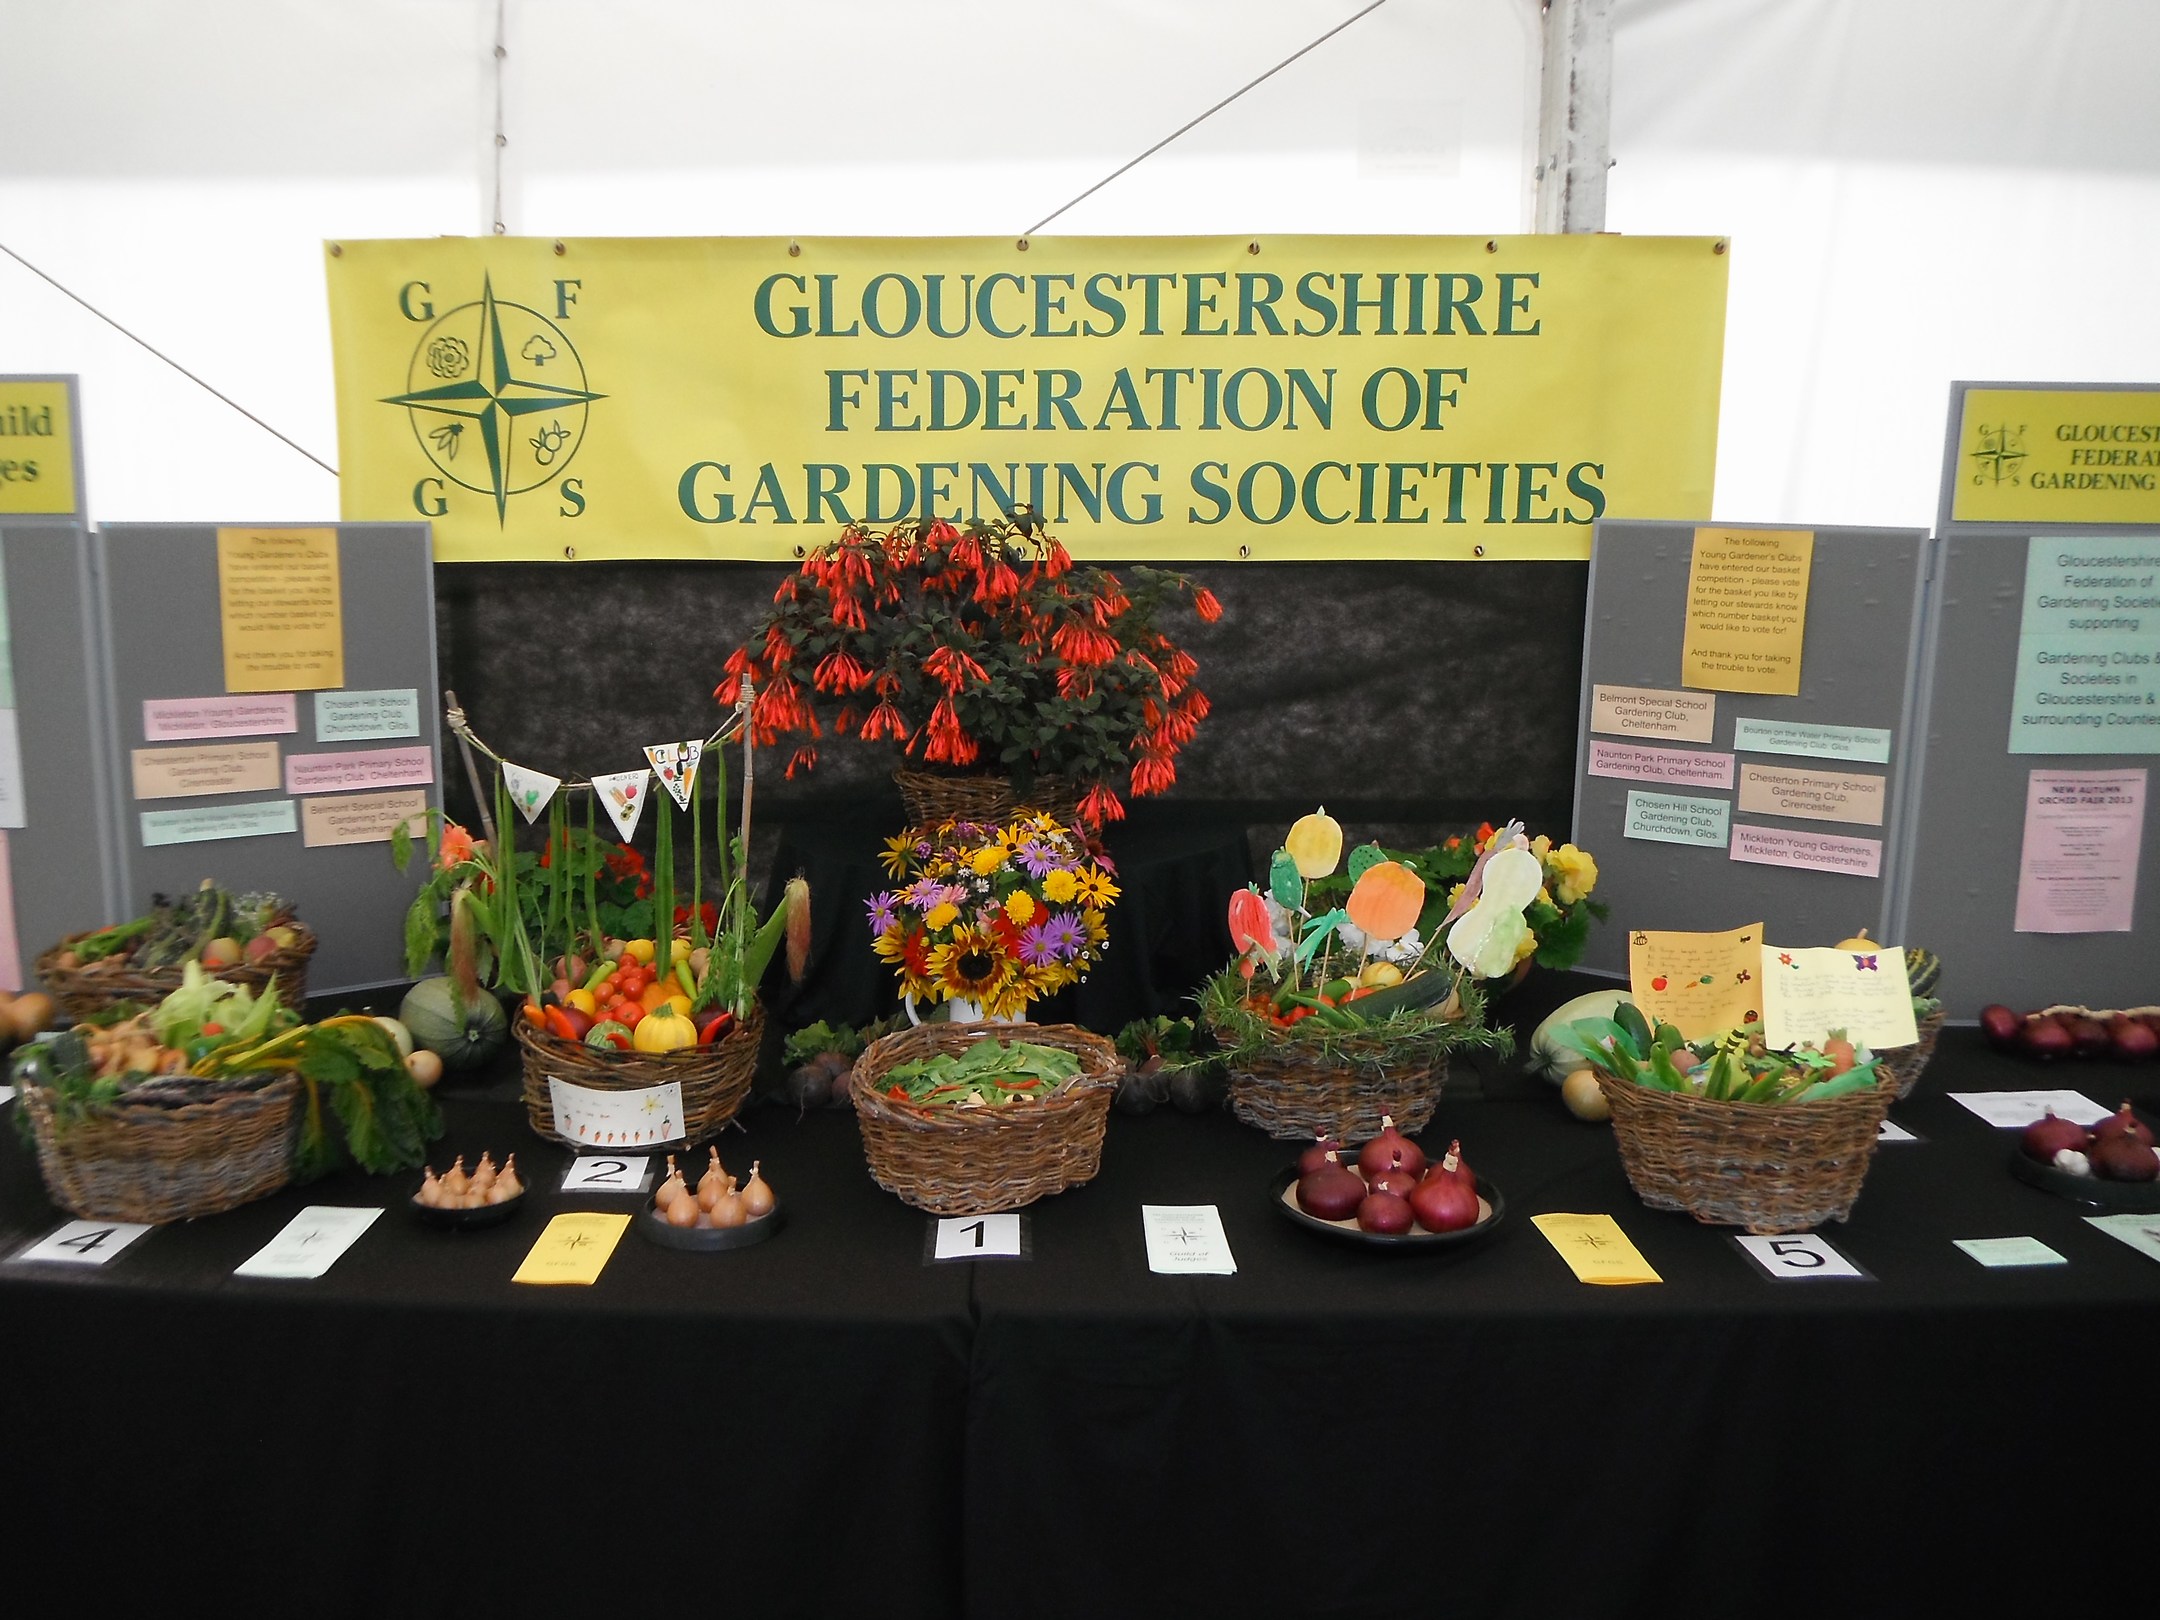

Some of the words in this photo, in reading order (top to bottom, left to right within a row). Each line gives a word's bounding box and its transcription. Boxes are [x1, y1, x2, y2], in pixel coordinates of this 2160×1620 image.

[399, 280, 435, 322] G
[553, 279, 582, 320] F
[753, 271, 1541, 339] GLOUCESTERSHIRE
[824, 367, 1337, 432] FEDERATION
[1361, 367, 1468, 432] OF
[0, 405, 53, 436] ild
[0, 459, 39, 487] es
[2031, 472, 2156, 490] GARDENING
[413, 478, 449, 518] G
[560, 478, 587, 519] S
[677, 461, 1165, 525] GARDENING
[1188, 461, 1607, 525] SOCIETIES
[1725, 537, 1740, 545] The
[1742, 538, 1780, 548] following
[1700, 551, 1726, 560] Young
[1778, 553, 1802, 562] Clubs
[2058, 554, 2160, 567] Gloucestershire
[1700, 563, 1719, 571] have
[1722, 564, 1753, 572] entered
[1772, 565, 1800, 574] basket
[1697, 575, 1744, 585] competition
[1752, 578, 1780, 587] please
[1782, 579, 1800, 587] vote
[2064, 576, 2136, 588] Federation
[2141, 576, 2153, 588] of
[1696, 586, 1707, 594] for
[1709, 586, 1722, 595] the
[1724, 587, 1751, 596] basket
[1754, 590, 1769, 598] you
[1771, 589, 1786, 598] like
[1788, 590, 1798, 600] by
[1693, 598, 1718, 608] letting
[1736, 600, 1773, 609] stewards
[1775, 602, 1798, 610] know
[2038, 595, 2109, 611] Gardening
[2113, 596, 2160, 608] Societi
[1692, 610, 1716, 618] which
[1717, 611, 1749, 620] number
[1751, 612, 1780, 621] basket
[1781, 615, 1797, 624] you
[2069, 618, 2140, 631] supporting
[1725, 624, 1740, 632] like
[1752, 625, 1770, 633] vote
[1691, 649, 1707, 657] And
[1709, 650, 1732, 659] thank
[1734, 652, 1749, 661] you
[1751, 652, 1763, 661] for
[1765, 654, 1791, 663] taking
[2037, 651, 2107, 667] Gardening
[2112, 651, 2149, 664] Clubs
[1701, 661, 1714, 670] the
[1716, 662, 1745, 672] trouble
[1747, 664, 1755, 672] to
[2060, 672, 2120, 685] Societies
[2126, 672, 2137, 684] in
[1600, 693, 1636, 704] Belmont
[1639, 697, 1672, 707] Special
[1675, 699, 1707, 710] School
[2036, 692, 2142, 705] Gloucestershire
[2145, 693, 2155, 705] &
[1615, 707, 1661, 720] Gardening
[1664, 711, 1689, 722] Club,
[2022, 713, 2101, 727] surrounding
[1769, 738, 1808, 749] Gardening
[1597, 749, 1632, 760] Naunton
[1635, 753, 1654, 762] Park
[1657, 755, 1691, 766] Primary
[1694, 758, 1726, 768] School
[1596, 760, 1640, 774] Gardening
[1749, 772, 1799, 785] Chesterton
[1802, 778, 1839, 790] Primary
[1842, 781, 1876, 793] School
[1772, 786, 1821, 801] Gardening
[1635, 798, 1670, 810] Chosen
[1672, 803, 1688, 812] Hill
[1690, 804, 1722, 816] School
[1640, 811, 1688, 825] Gardening
[1740, 833, 1784, 846] Mickleton
[1787, 838, 1817, 851] Young
[1793, 851, 1868, 868] Gloucestershire
[582, 1160, 627, 1183] 2
[58, 1228, 118, 1254] 4
[960, 1220, 985, 1248] 1
[1768, 1240, 1826, 1268] 5
